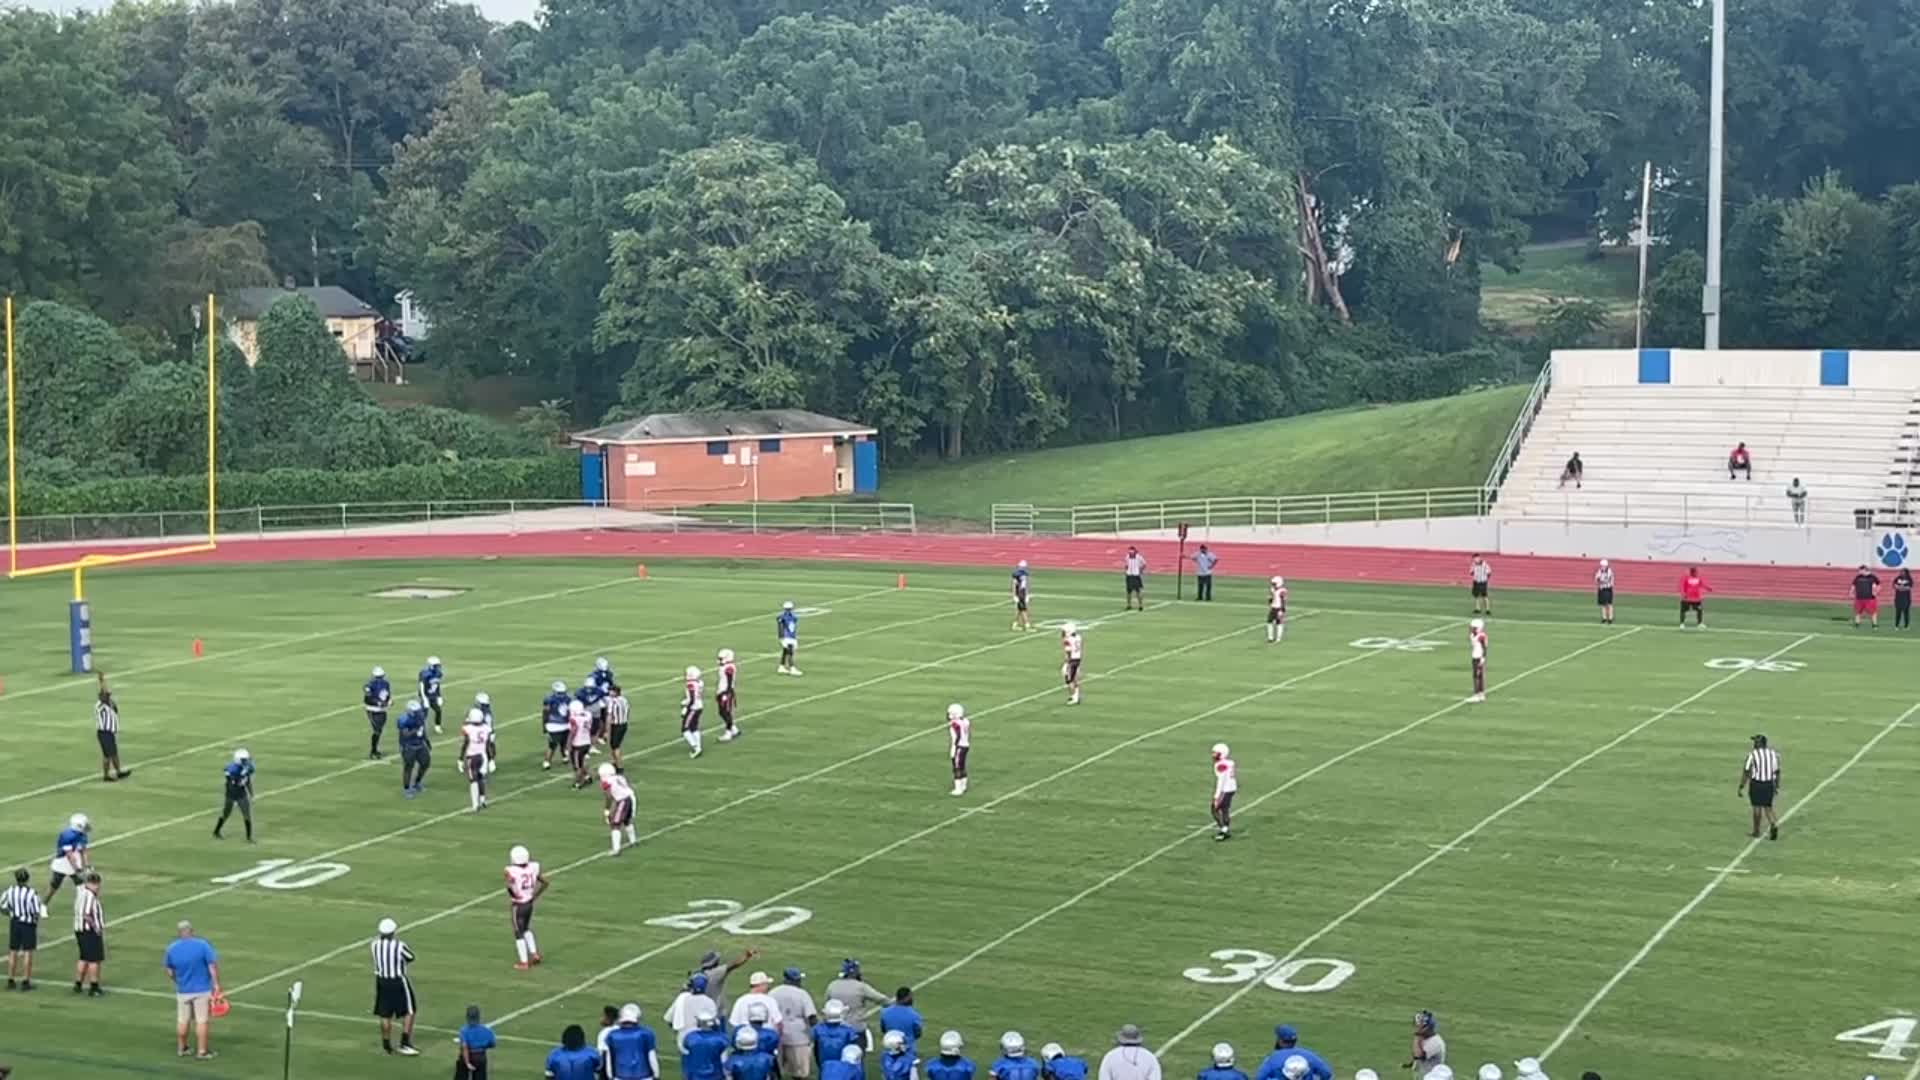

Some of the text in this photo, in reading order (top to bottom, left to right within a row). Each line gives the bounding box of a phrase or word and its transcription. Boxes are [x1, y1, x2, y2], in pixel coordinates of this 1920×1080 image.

[1704, 657, 1808, 672] 30
[210, 858, 351, 889] 10
[520, 873, 535, 890] 21
[643, 899, 813, 934] 20
[1182, 949, 1356, 993] 30
